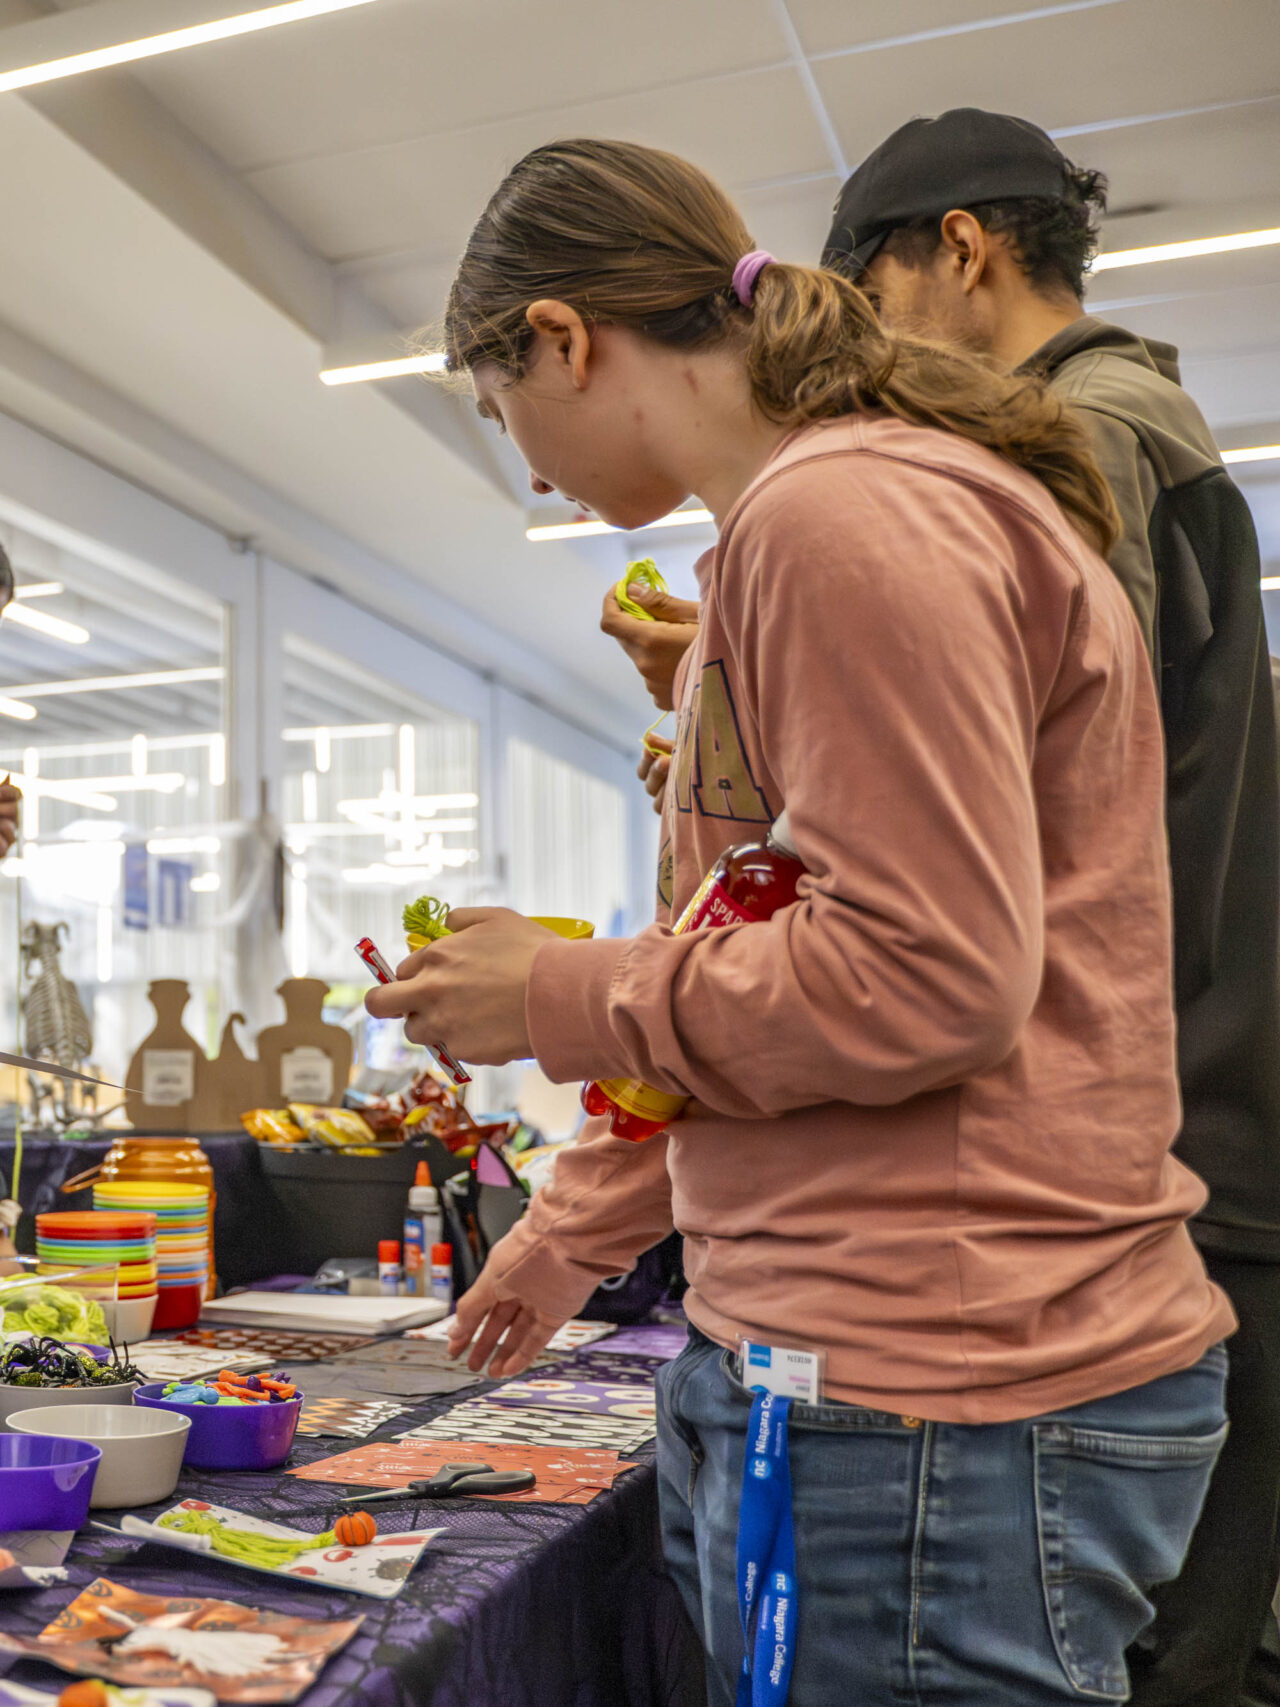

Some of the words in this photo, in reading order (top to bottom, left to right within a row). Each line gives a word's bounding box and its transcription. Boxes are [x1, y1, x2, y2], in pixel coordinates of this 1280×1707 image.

[755, 1410, 770, 1454] Niagara
[754, 1459, 767, 1478] nc
[745, 1561, 756, 1601] College
[776, 1573, 786, 1591] nc
[773, 1597, 788, 1642] Niagara
[769, 1644, 786, 1685] College
